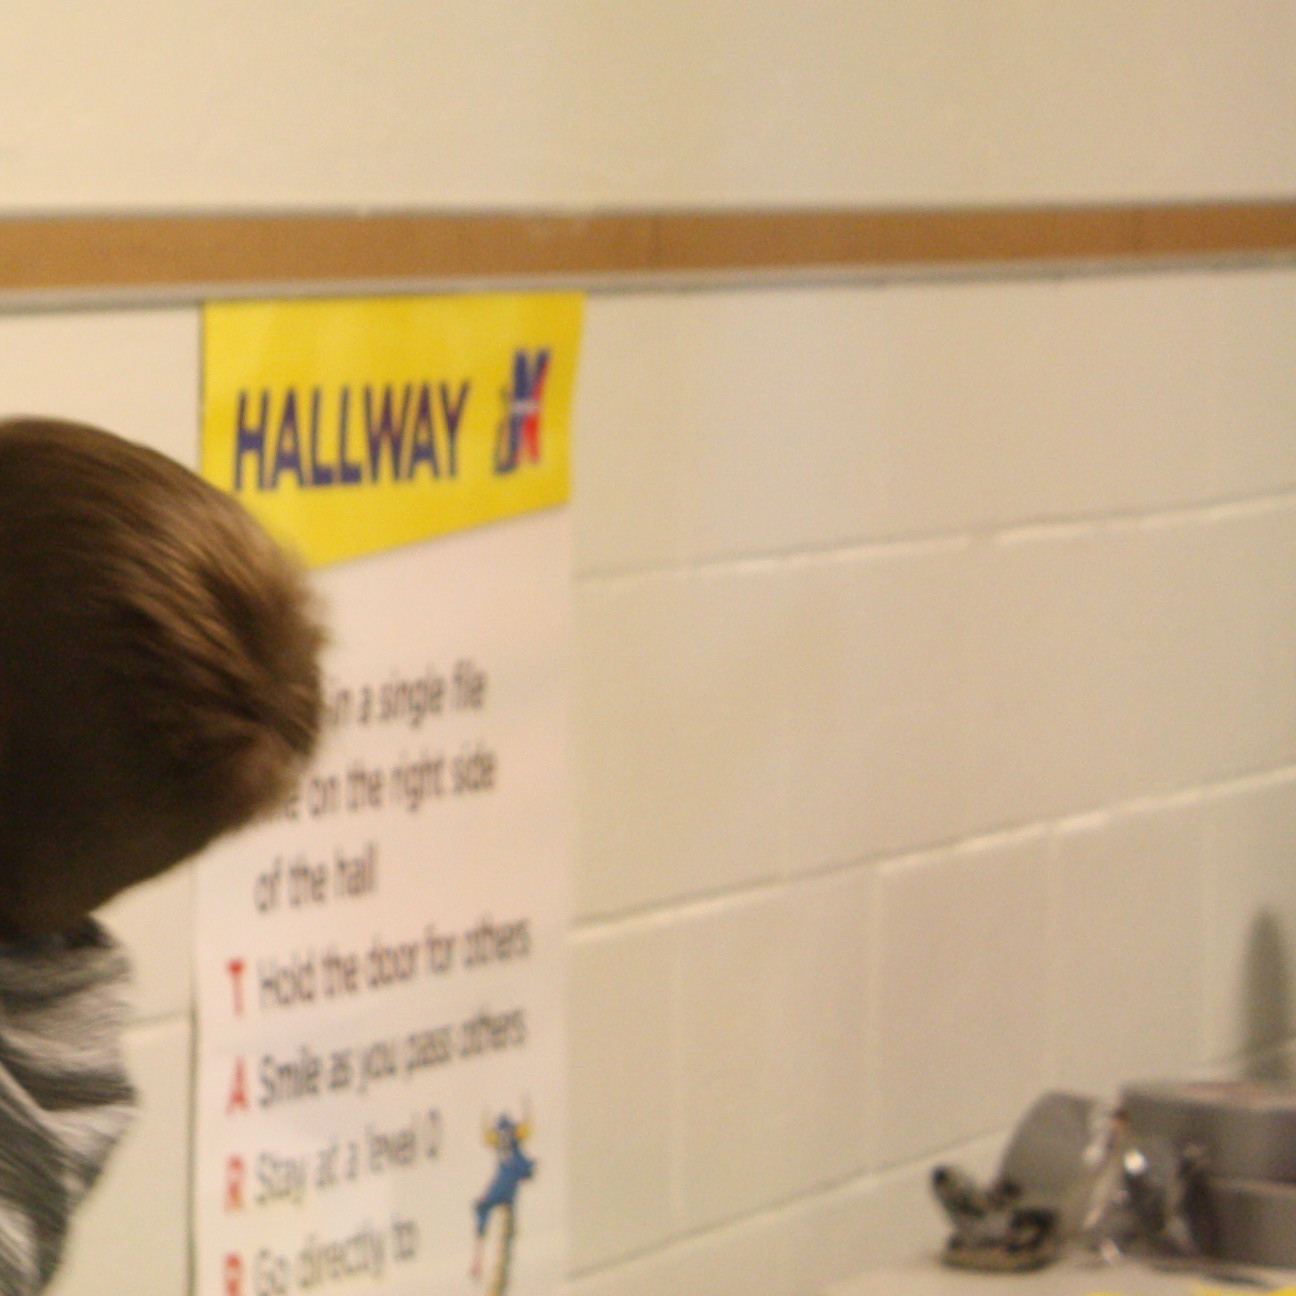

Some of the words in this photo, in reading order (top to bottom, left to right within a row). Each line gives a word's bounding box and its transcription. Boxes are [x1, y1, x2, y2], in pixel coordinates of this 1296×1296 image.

[234, 378, 472, 492] HALLWAY
[359, 683, 372, 724] a
[379, 666, 445, 728] single
[453, 658, 488, 710] file
[346, 758, 382, 810] the
[391, 748, 444, 814] right
[453, 740, 496, 795] side
[255, 853, 283, 912] of
[288, 853, 326, 907] the
[334, 841, 378, 896] hall
[227, 958, 245, 1016] T
[259, 951, 314, 1008] Hold
[321, 944, 358, 997] the
[367, 932, 420, 987] door
[464, 914, 529, 968] others
[226, 1055, 248, 1116] A
[259, 1042, 318, 1107] Smile
[329, 1049, 352, 1090] as
[360, 1040, 397, 1095] you
[405, 1023, 451, 1082] pass
[459, 1006, 526, 1060] others
[225, 1153, 244, 1212] R
[257, 1151, 305, 1205] Stay
[366, 1114, 418, 1174] level
[298, 1220, 385, 1289] directly
[393, 1212, 418, 1261] to
